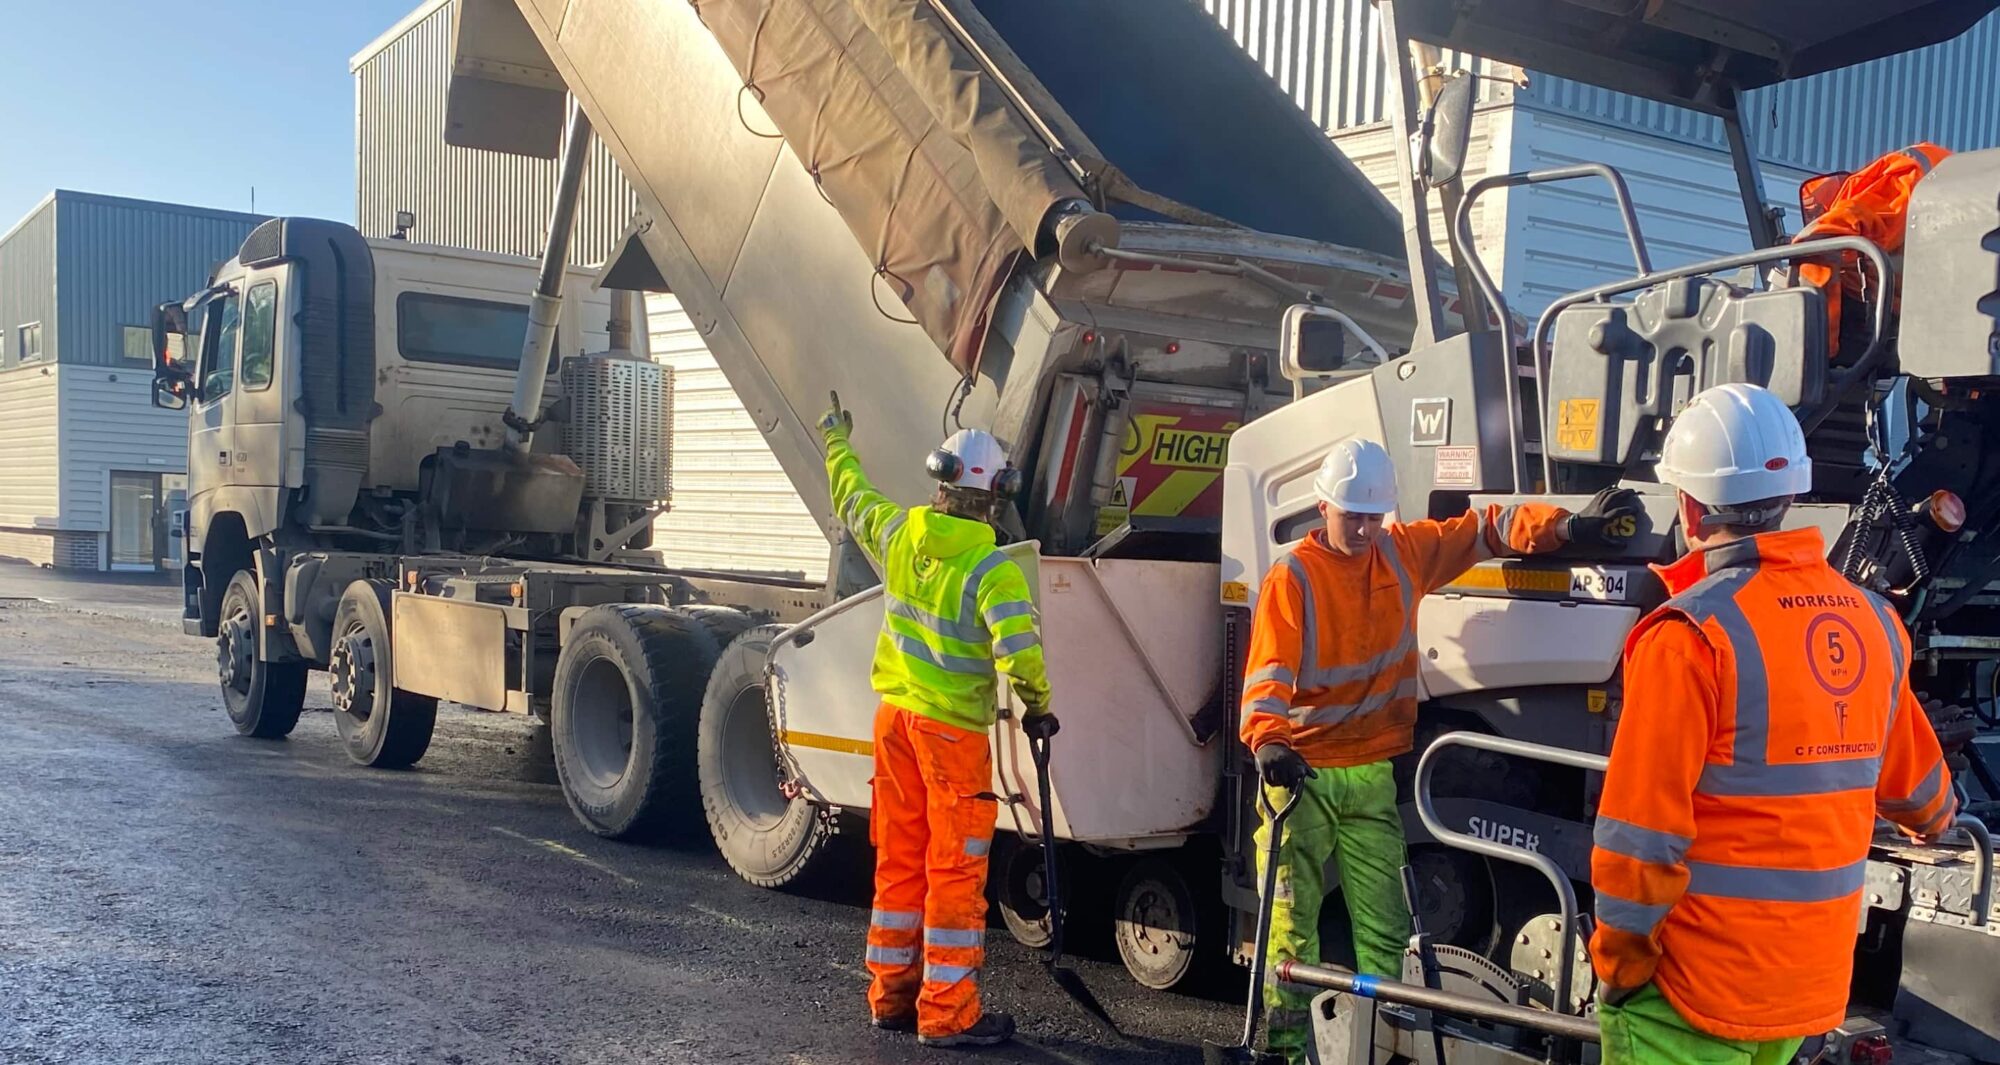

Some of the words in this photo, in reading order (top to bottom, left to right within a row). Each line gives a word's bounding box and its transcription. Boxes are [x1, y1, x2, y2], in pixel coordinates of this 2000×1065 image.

[1416, 409, 1443, 434] W
[1154, 432, 1230, 465] HIGH
[1439, 450, 1473, 459] WARNING
[1572, 575, 1592, 592] AP
[1597, 575, 1624, 594] 304
[1777, 594, 1860, 609] WORKSAFE
[1827, 631, 1845, 665] 5
[1830, 668, 1848, 677] MPH
[1795, 746, 1804, 756] C
[1808, 746, 1814, 756] F
[1467, 816, 1540, 852] SUPER
